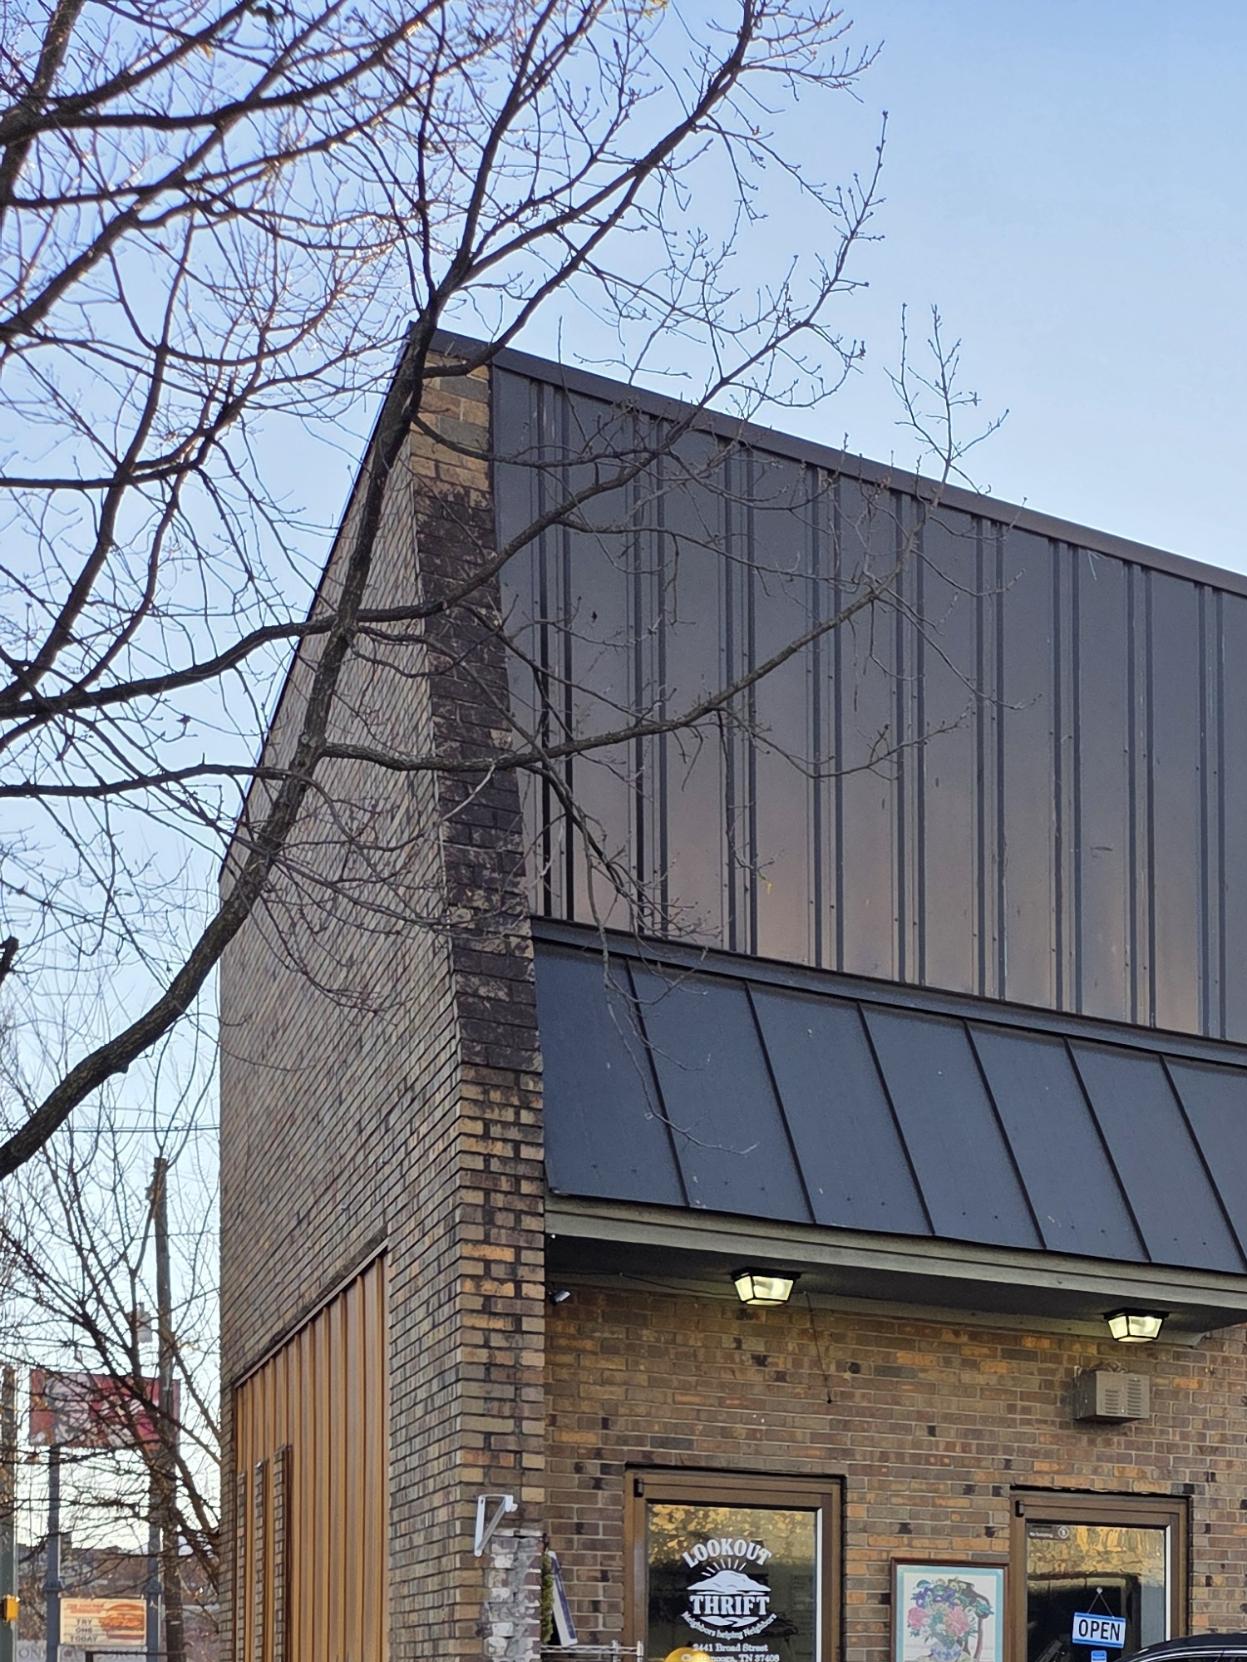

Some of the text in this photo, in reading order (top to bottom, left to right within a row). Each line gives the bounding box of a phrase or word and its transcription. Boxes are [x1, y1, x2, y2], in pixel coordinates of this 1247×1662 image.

[682, 1538, 772, 1568] LOOKOUT
[689, 1595, 770, 1615] THRIFT
[76, 1618, 93, 1626] TRY
[681, 1611, 717, 1637] Neighbors
[743, 1613, 777, 1637] Neighbors
[1078, 1618, 1121, 1642] OPEN
[715, 1643, 740, 1652] Broad
[742, 1643, 769, 1652] Street
[738, 1653, 753, 1662] TN
